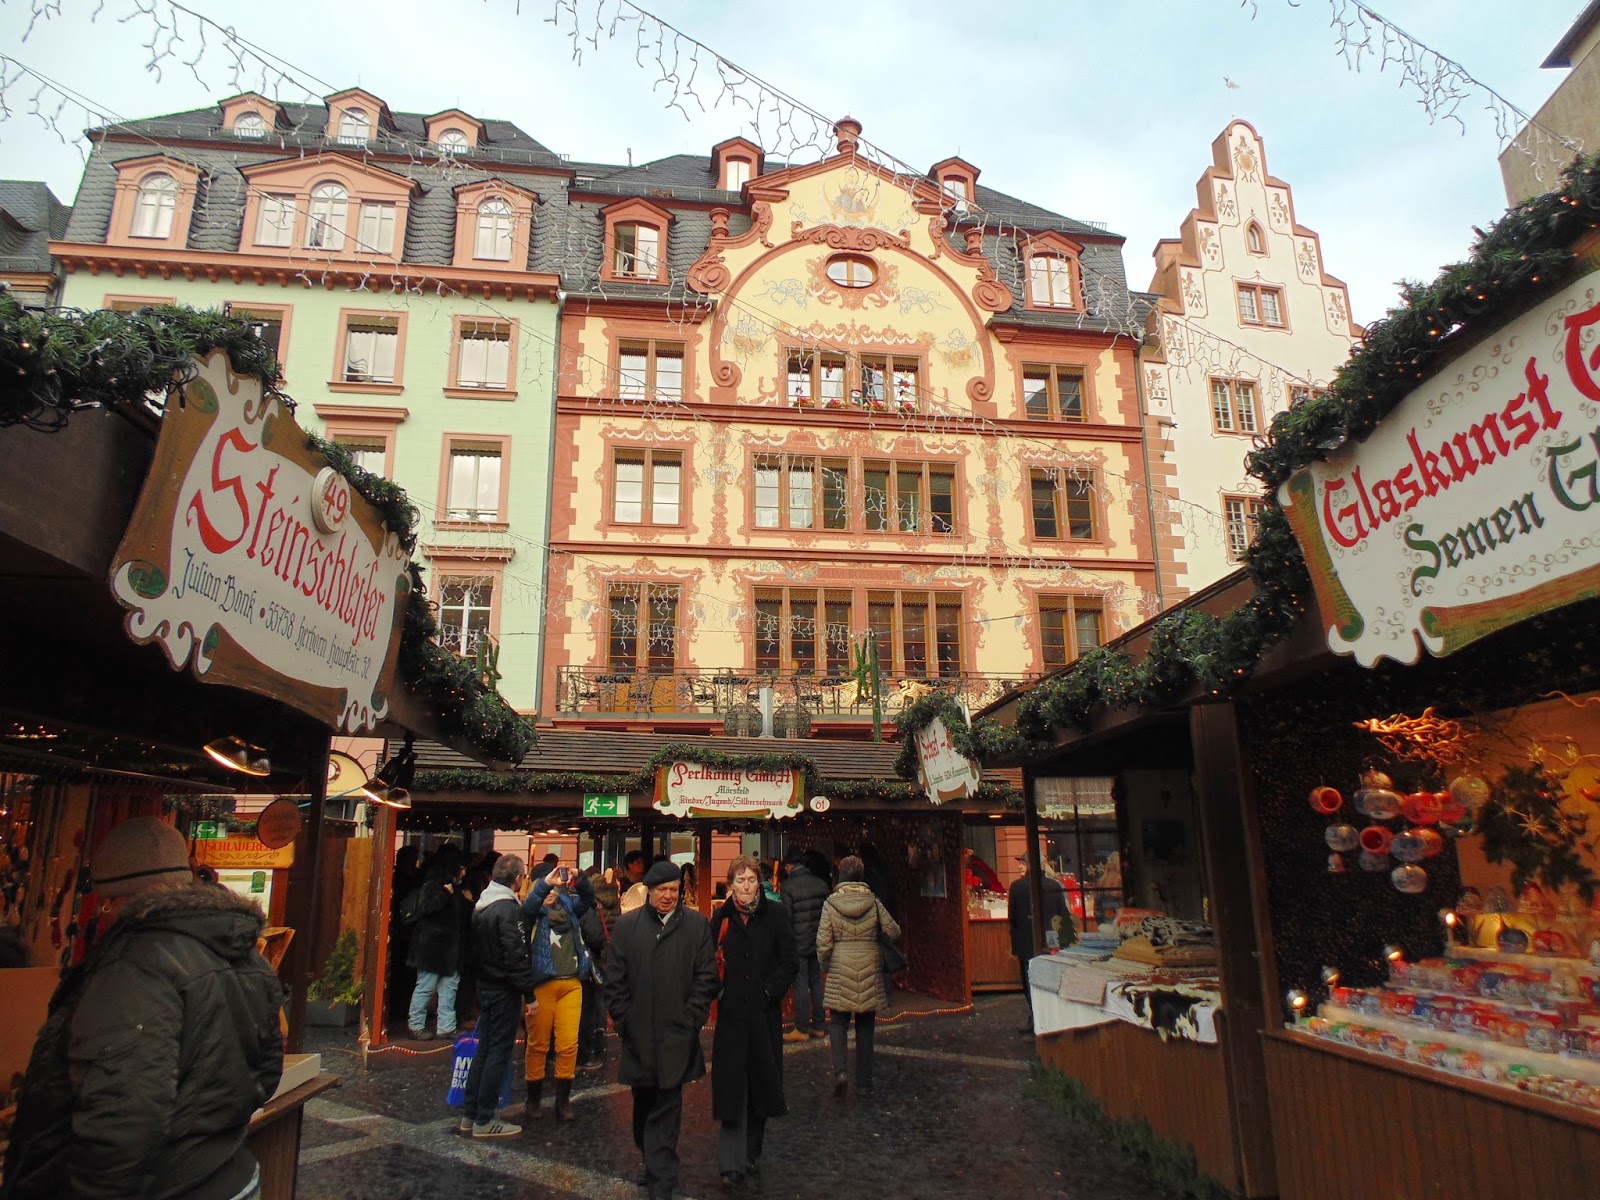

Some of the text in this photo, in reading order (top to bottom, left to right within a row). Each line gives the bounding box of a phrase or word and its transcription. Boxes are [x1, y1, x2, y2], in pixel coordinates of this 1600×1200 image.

[1323, 356, 1563, 548] Glaskunst
[324, 476, 347, 524] 49
[186, 426, 385, 646] Steinschleifer
[1403, 490, 1544, 598] Semen
[172, 546, 222, 602] Julian
[265, 600, 295, 640] 55758
[715, 785, 750, 796] Mörsfeld
[745, 766, 791, 788] GmbH
[815, 800, 826, 810] 61
[455, 1056, 473, 1070] MY
